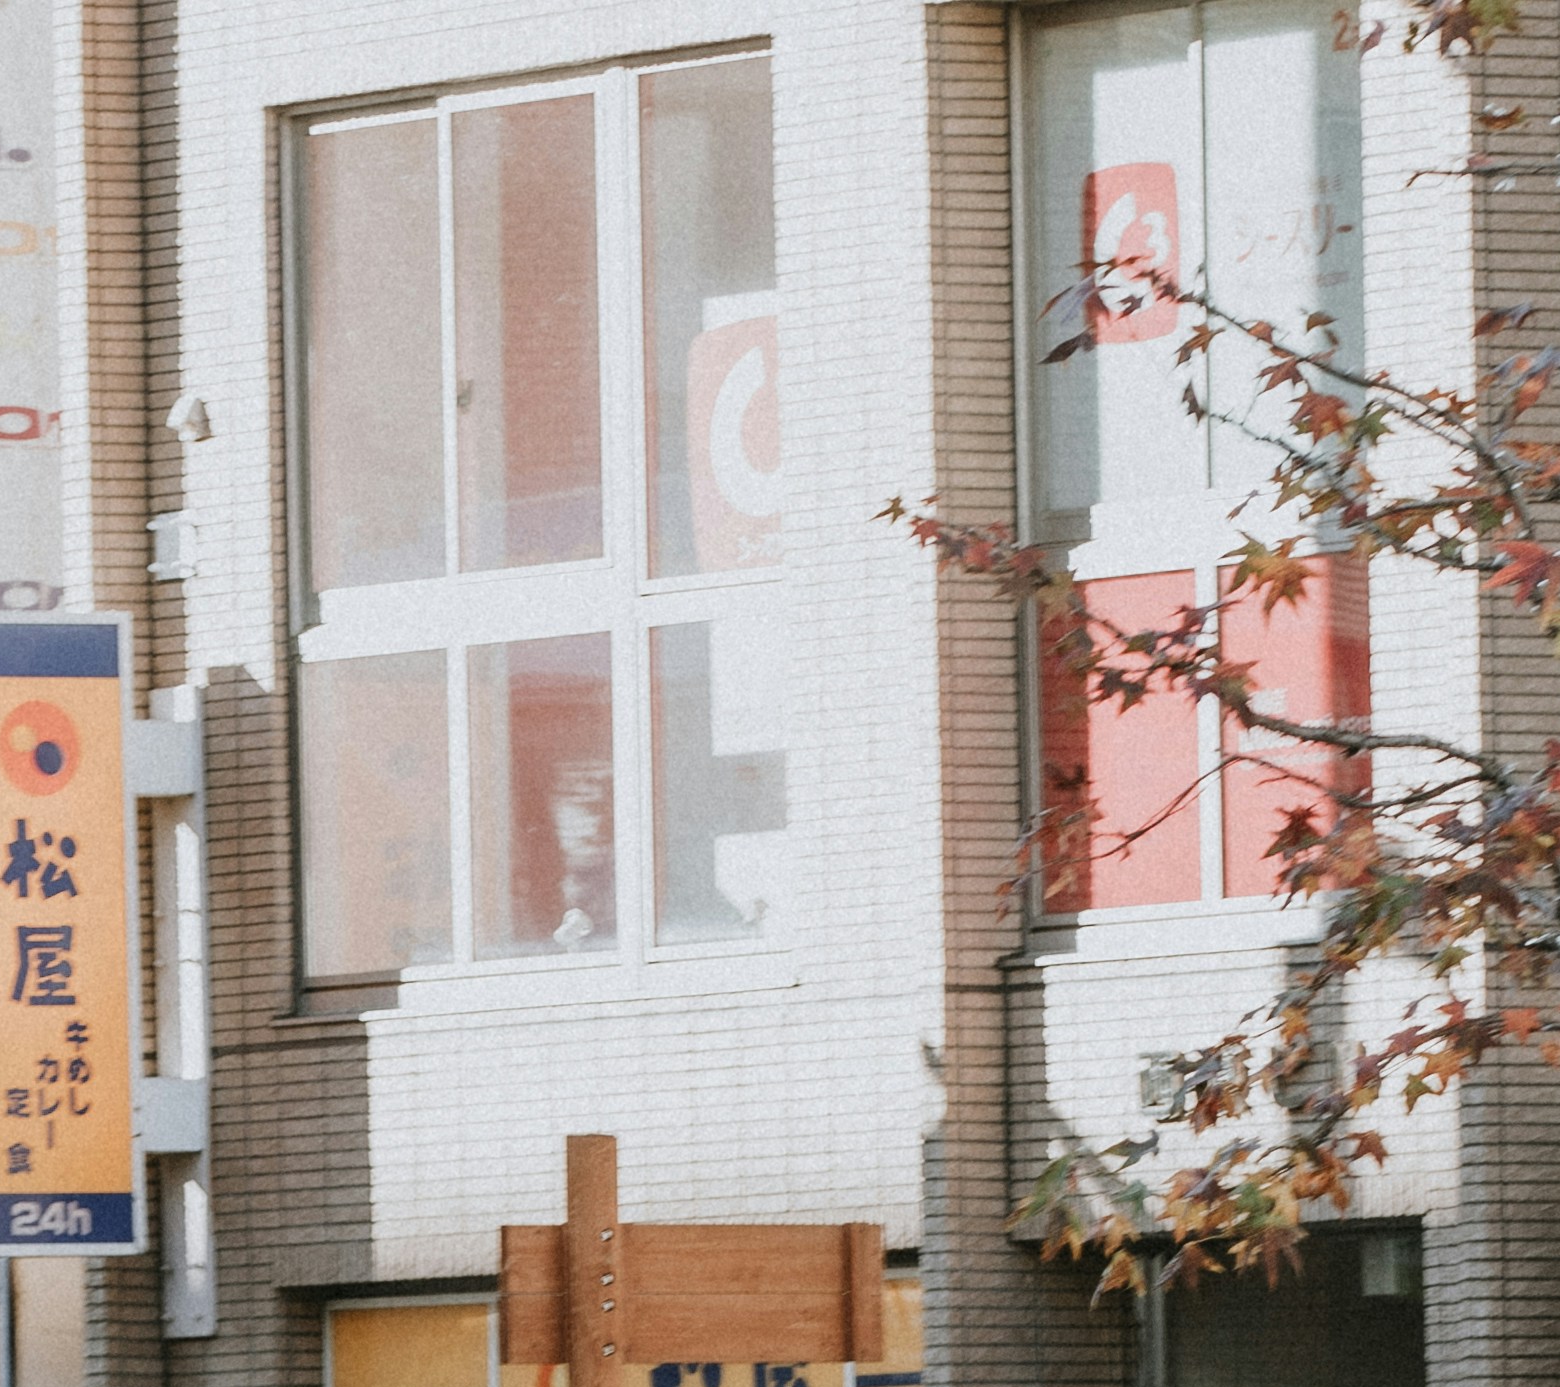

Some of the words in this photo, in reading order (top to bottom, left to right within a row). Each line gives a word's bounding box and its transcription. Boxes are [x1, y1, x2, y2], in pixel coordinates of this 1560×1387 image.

[1, 817, 78, 1006] 松屋
[35, 1054, 62, 1151] カレー
[66, 1020, 93, 1117] 牛めし
[4, 1087, 34, 1176] 定食
[9, 1200, 94, 1238] 24h
